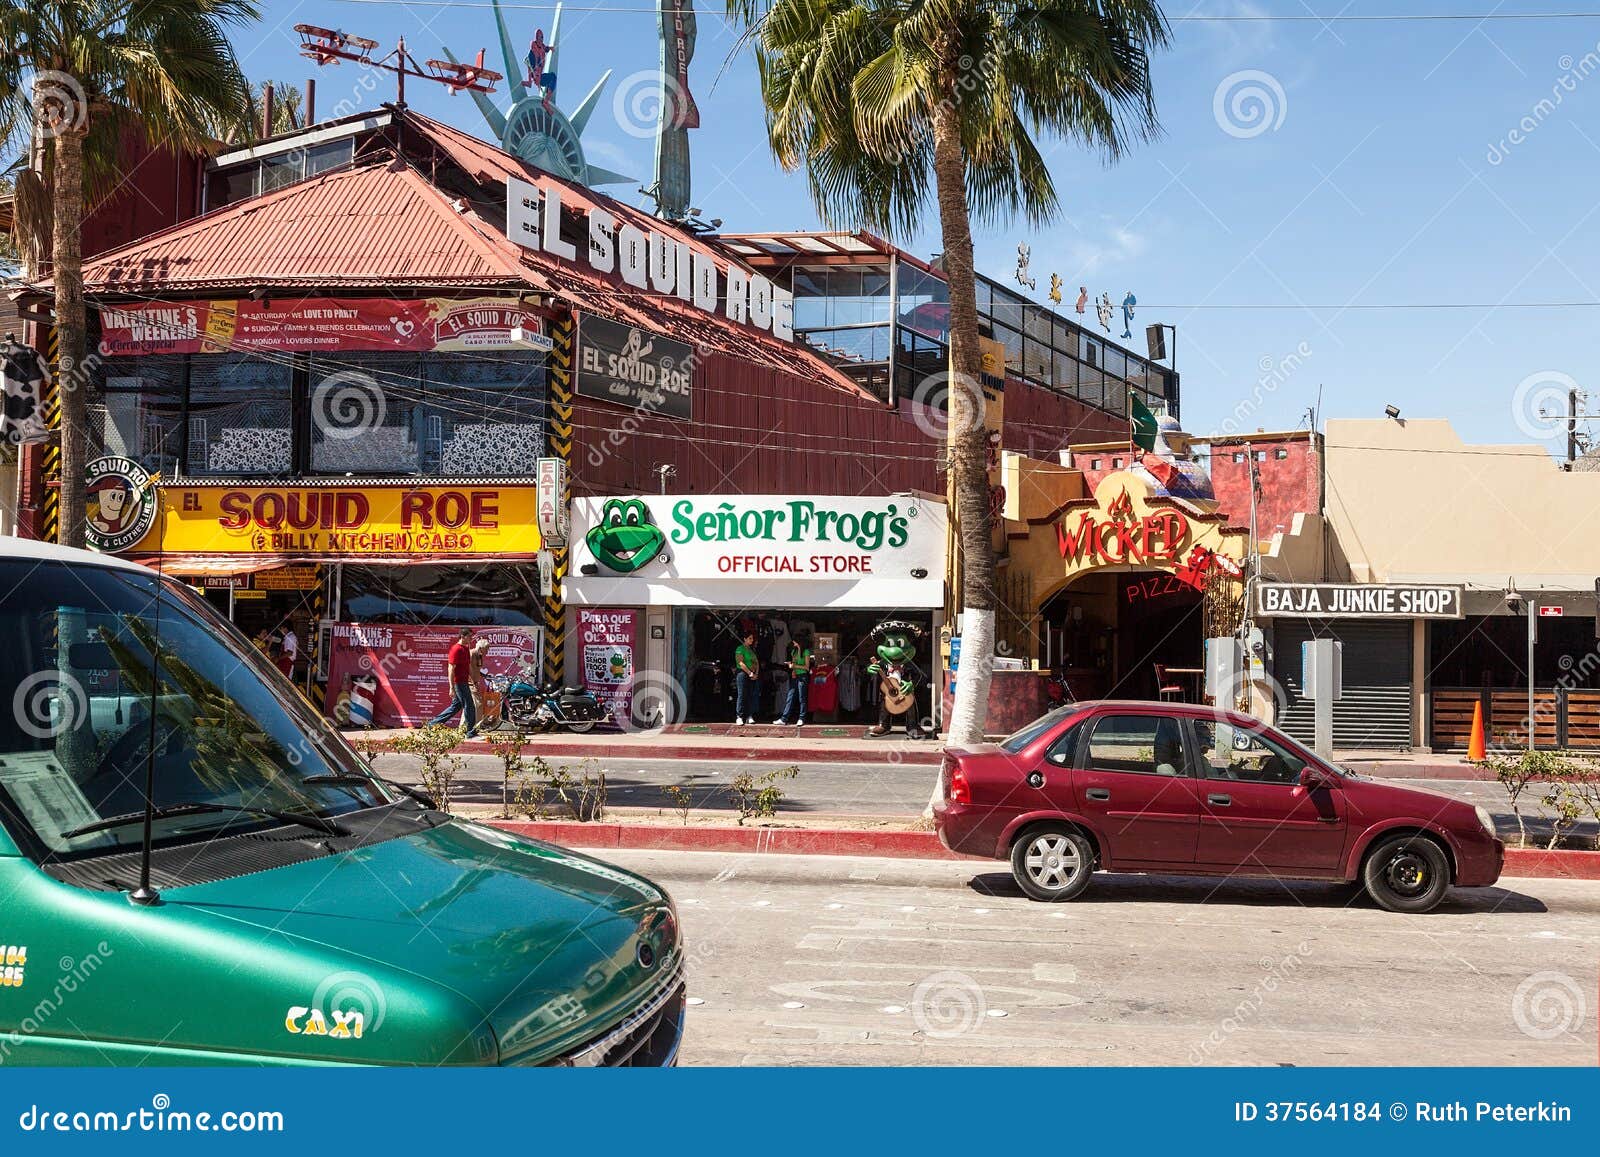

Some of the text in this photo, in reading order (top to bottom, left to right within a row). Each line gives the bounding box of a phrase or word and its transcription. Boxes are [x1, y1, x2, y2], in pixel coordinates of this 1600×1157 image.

[507, 175, 794, 343] EL SQUID ROE
[303, 309, 321, 319] LOVE
[323, 309, 333, 318] TO
[334, 309, 358, 319] PARTY
[448, 311, 527, 333] EL SQUID ROE
[131, 324, 198, 342] WEEKEND
[251, 325, 279, 333] SUNDAY
[345, 324, 391, 332] CELEBRATION
[252, 337, 281, 345] MONDAY
[583, 346, 691, 396] EL SQUID ROE
[91, 459, 130, 476] SQUID
[541, 462, 554, 495] EAT
[183, 491, 500, 530] EL SQUID ROE
[541, 501, 554, 523] AT
[671, 500, 909, 550] Señor Frog's
[271, 533, 318, 550] BILLY
[415, 533, 474, 550] CABO
[1054, 507, 1188, 565] WICKED
[717, 555, 872, 573] OFFICIAL STORE
[1126, 574, 1193, 604] PIZZA
[1266, 588, 1452, 613] BAJA JUNKIE SHOP
[581, 611, 632, 624] PARA QUE
[592, 624, 621, 633] NO TE
[488, 633, 526, 646] SQUID ROE
